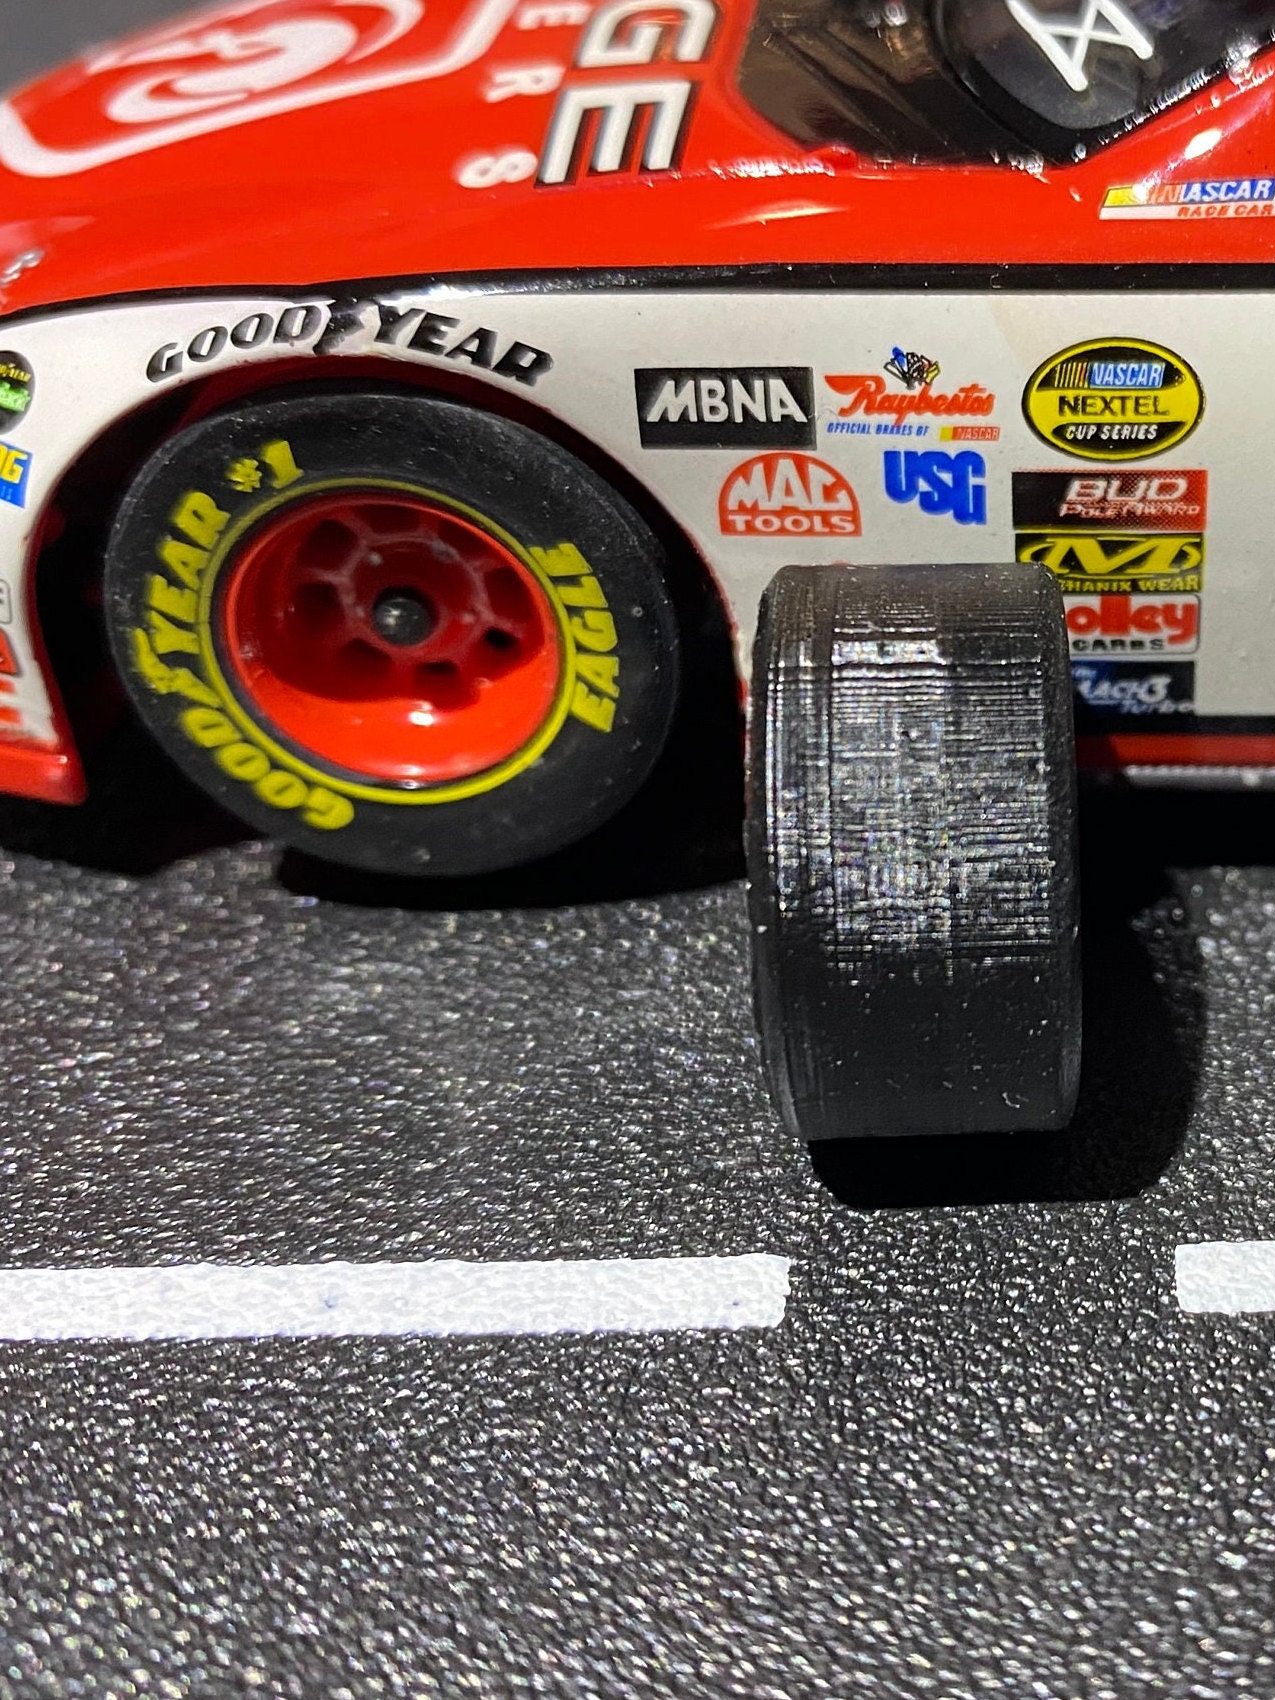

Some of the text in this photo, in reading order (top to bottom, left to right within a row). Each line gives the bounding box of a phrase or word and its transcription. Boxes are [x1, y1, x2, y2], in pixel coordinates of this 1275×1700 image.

[1155, 180, 1274, 204] NASCAR
[1177, 203, 1274, 218] RACE CAR
[1091, 362, 1162, 387] NASCAR
[646, 378, 808, 423] MBNA
[824, 375, 996, 428] Raybestos
[1058, 395, 1170, 417] NEXTEL
[826, 421, 1000, 441] OFFICIAL BRAKES OF NASCAR
[1065, 424, 1159, 440] CUP SERIES
[728, 458, 854, 511] MAC
[883, 450, 987, 526] USG
[1065, 477, 1188, 502] BUD
[728, 514, 856, 533] TOOLS
[1138, 574, 1199, 592] WEAR
[1066, 592, 1198, 645] olley
[530, 542, 621, 732] EAGLE
[1071, 638, 1164, 652] CARBS
